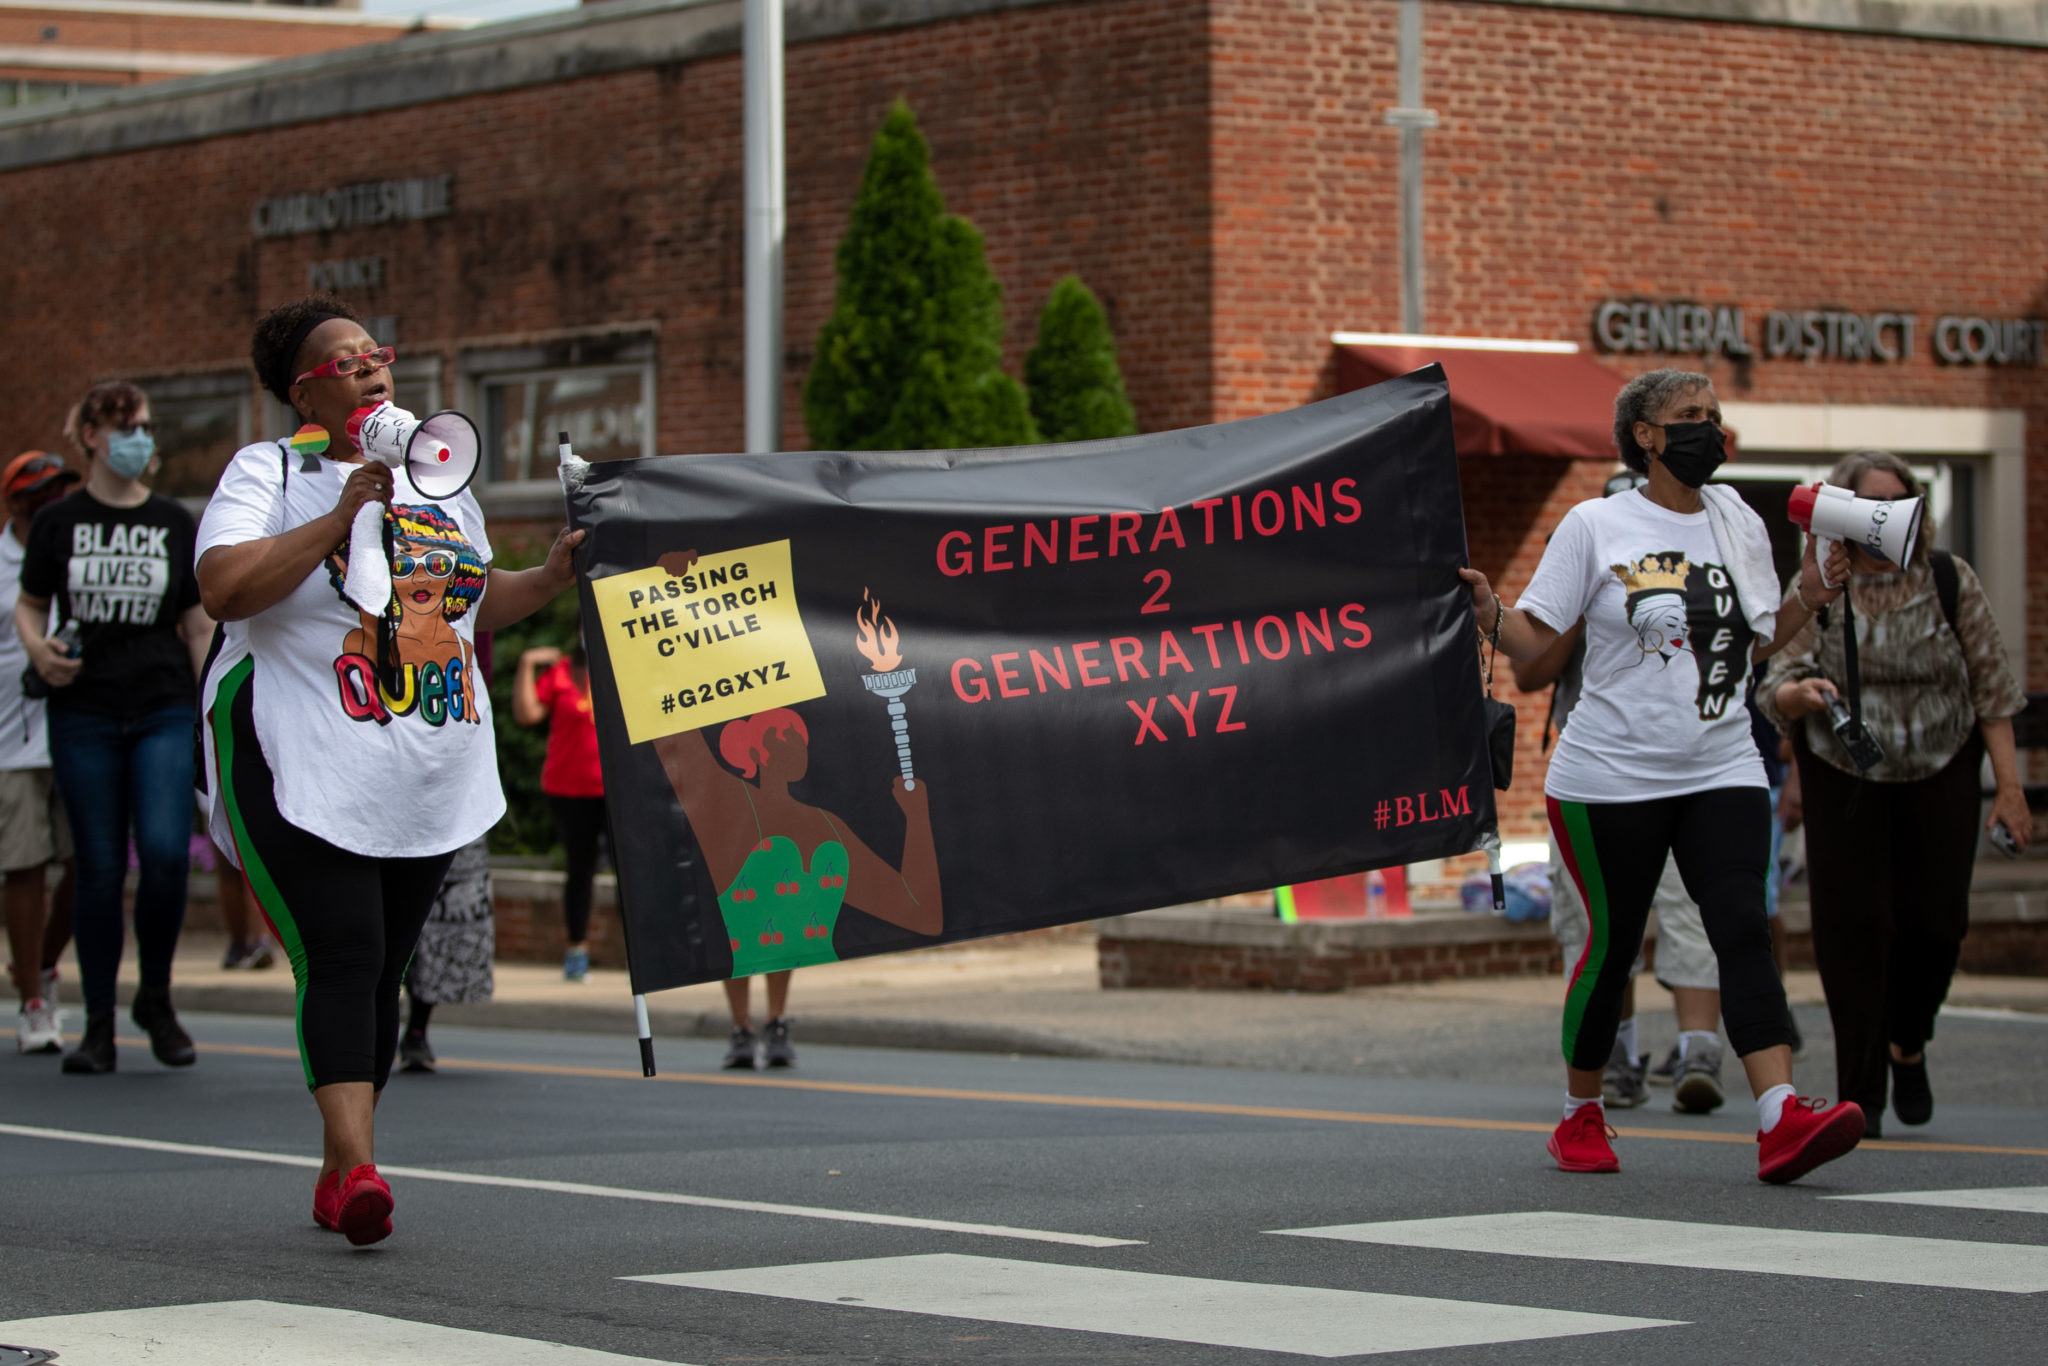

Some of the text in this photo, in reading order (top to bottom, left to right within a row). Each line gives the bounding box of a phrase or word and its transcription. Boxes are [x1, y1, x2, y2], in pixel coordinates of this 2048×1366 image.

[1599, 301, 2046, 364] GENERAL DISTRICT COURT
[72, 522, 169, 558] BLACK
[935, 477, 1363, 577] GENERATIONS
[82, 560, 153, 588] LIVES
[629, 562, 749, 609] PASSING
[1140, 568, 1173, 615] 2
[70, 591, 161, 625] MATTER
[621, 580, 778, 640] THE TORCH
[657, 613, 762, 658] C'VILLE
[950, 603, 1373, 704] GENERATIONS
[1706, 568, 1734, 716] QUEEN
[660, 660, 791, 716] #G2GXYZ
[1126, 685, 1247, 746] XYZ
[1373, 785, 1473, 831] #BLM
